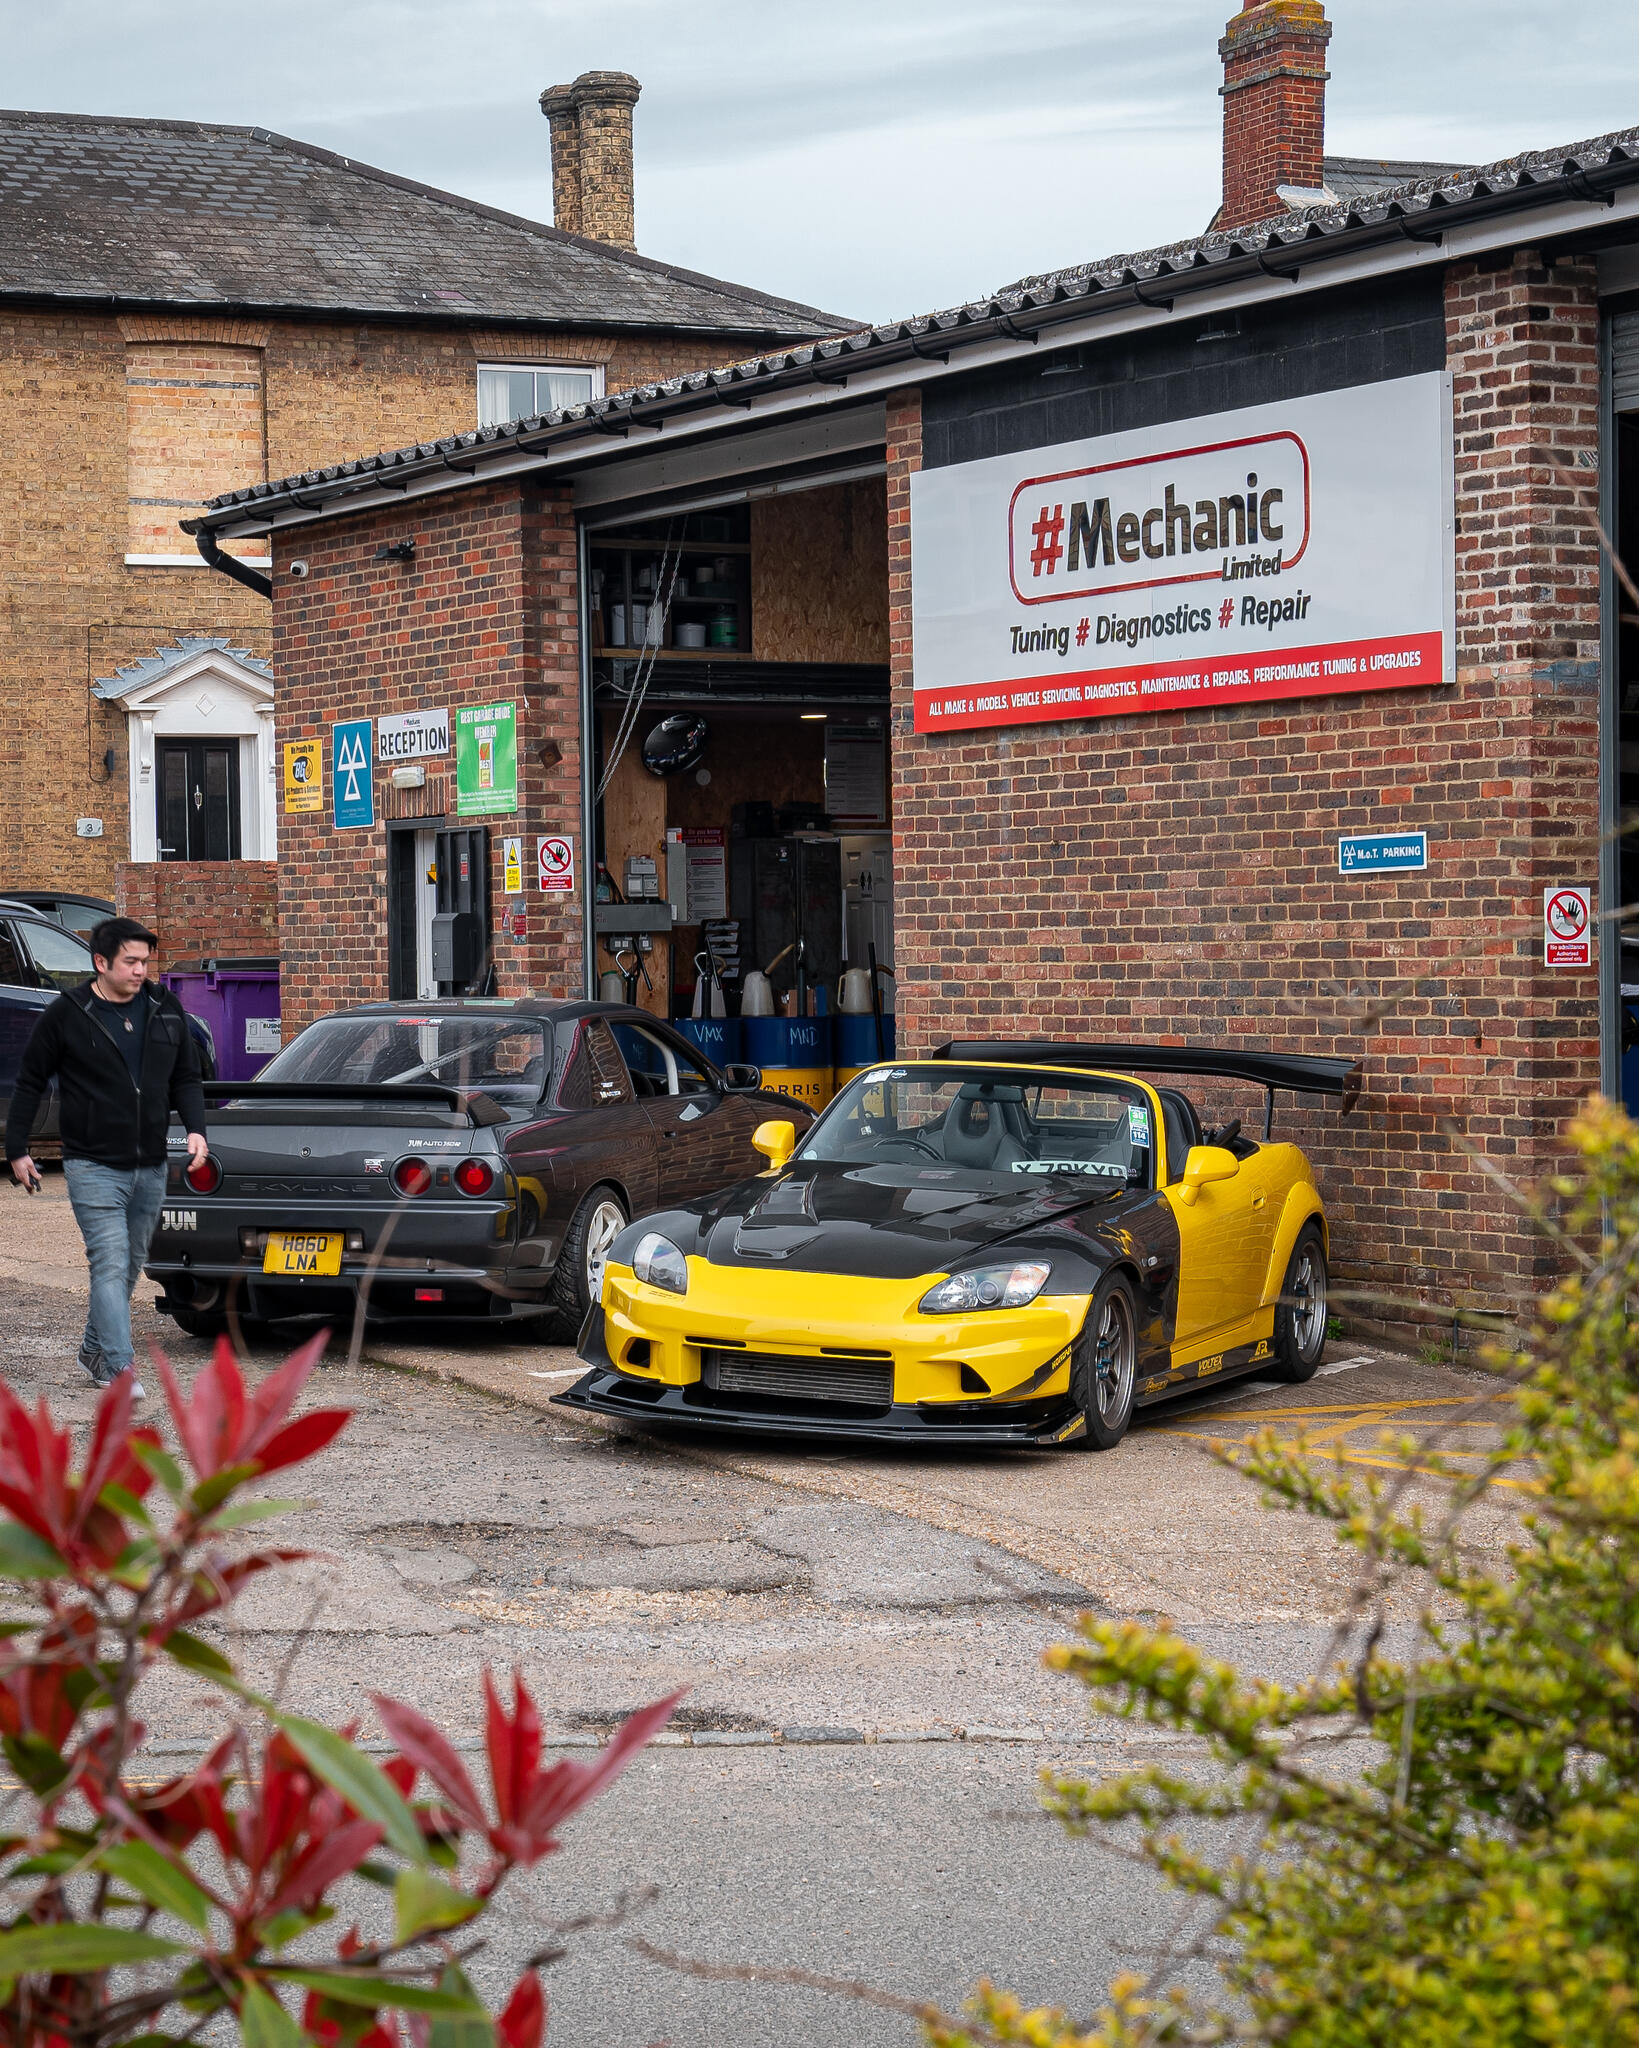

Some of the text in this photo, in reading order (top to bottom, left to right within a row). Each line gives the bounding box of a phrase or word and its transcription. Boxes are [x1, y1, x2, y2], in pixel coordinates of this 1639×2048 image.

[1030, 472, 1283, 577] #Mechanic
[1221, 549, 1282, 581] Limited
[1010, 623, 1069, 656] Tuning
[1096, 604, 1211, 648] Diagnostics
[1241, 590, 1311, 631] Repair
[929, 650, 1421, 717] ALL MAKE & MODELS, VEHICLE SERVICING, DIAGNOSTICS, MAINTENANCE & REPAIRS, PERFORMANCE TUNING & UPGRADES
[380, 726, 446, 756] RECEPTION
[87, 824, 93, 832] 3
[1383, 845, 1421, 858] PARKING
[694, 1024, 723, 1043] VMX
[763, 1083, 820, 1097] ORRIS
[1133, 1131, 1146, 1140] 114
[240, 1183, 371, 1192] SKYLINE
[162, 1211, 197, 1230] JUN
[282, 1236, 328, 1252] H860
[285, 1254, 317, 1270] LNA
[1198, 1354, 1223, 1372] VOLTEX
